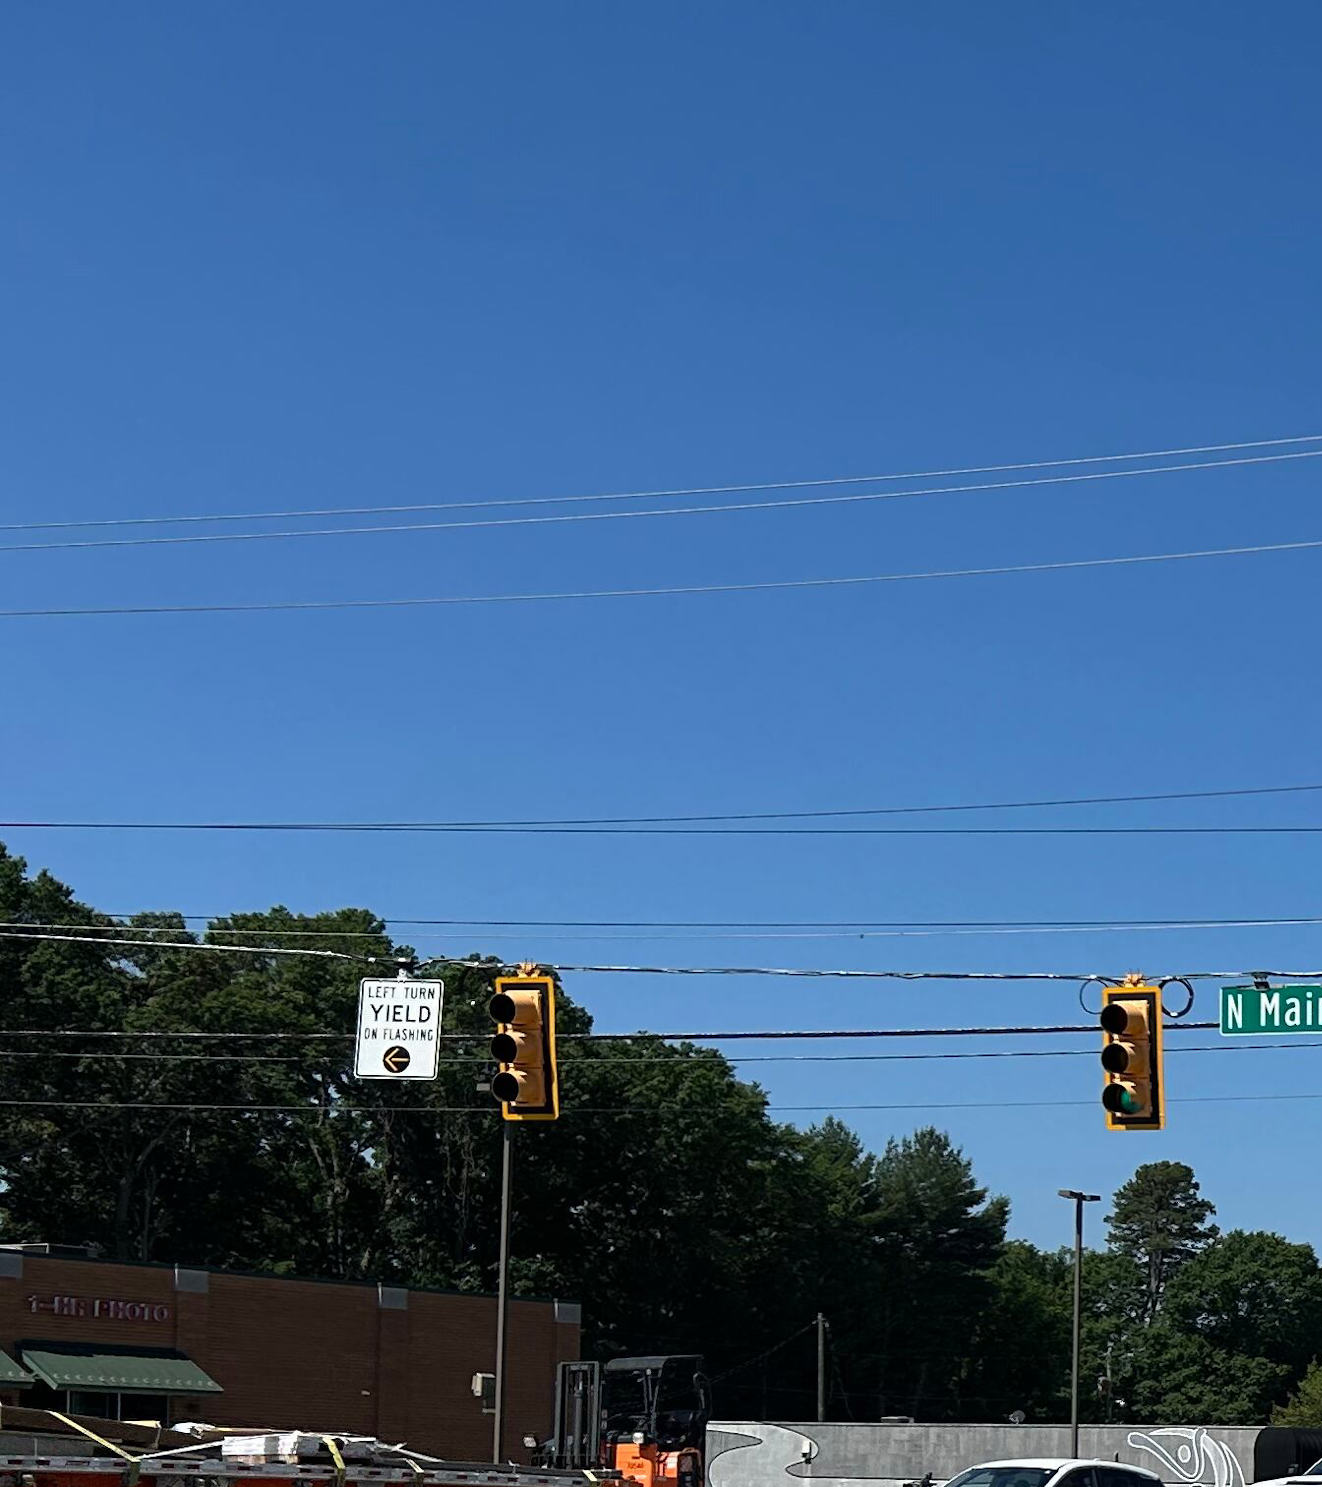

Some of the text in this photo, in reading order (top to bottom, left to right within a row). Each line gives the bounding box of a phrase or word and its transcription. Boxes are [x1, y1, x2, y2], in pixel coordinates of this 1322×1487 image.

[368, 986, 435, 999] LEFT TURN
[371, 1004, 431, 1023] YIELD
[1227, 994, 1243, 1029] N
[364, 1028, 433, 1041] ON FLASHING
